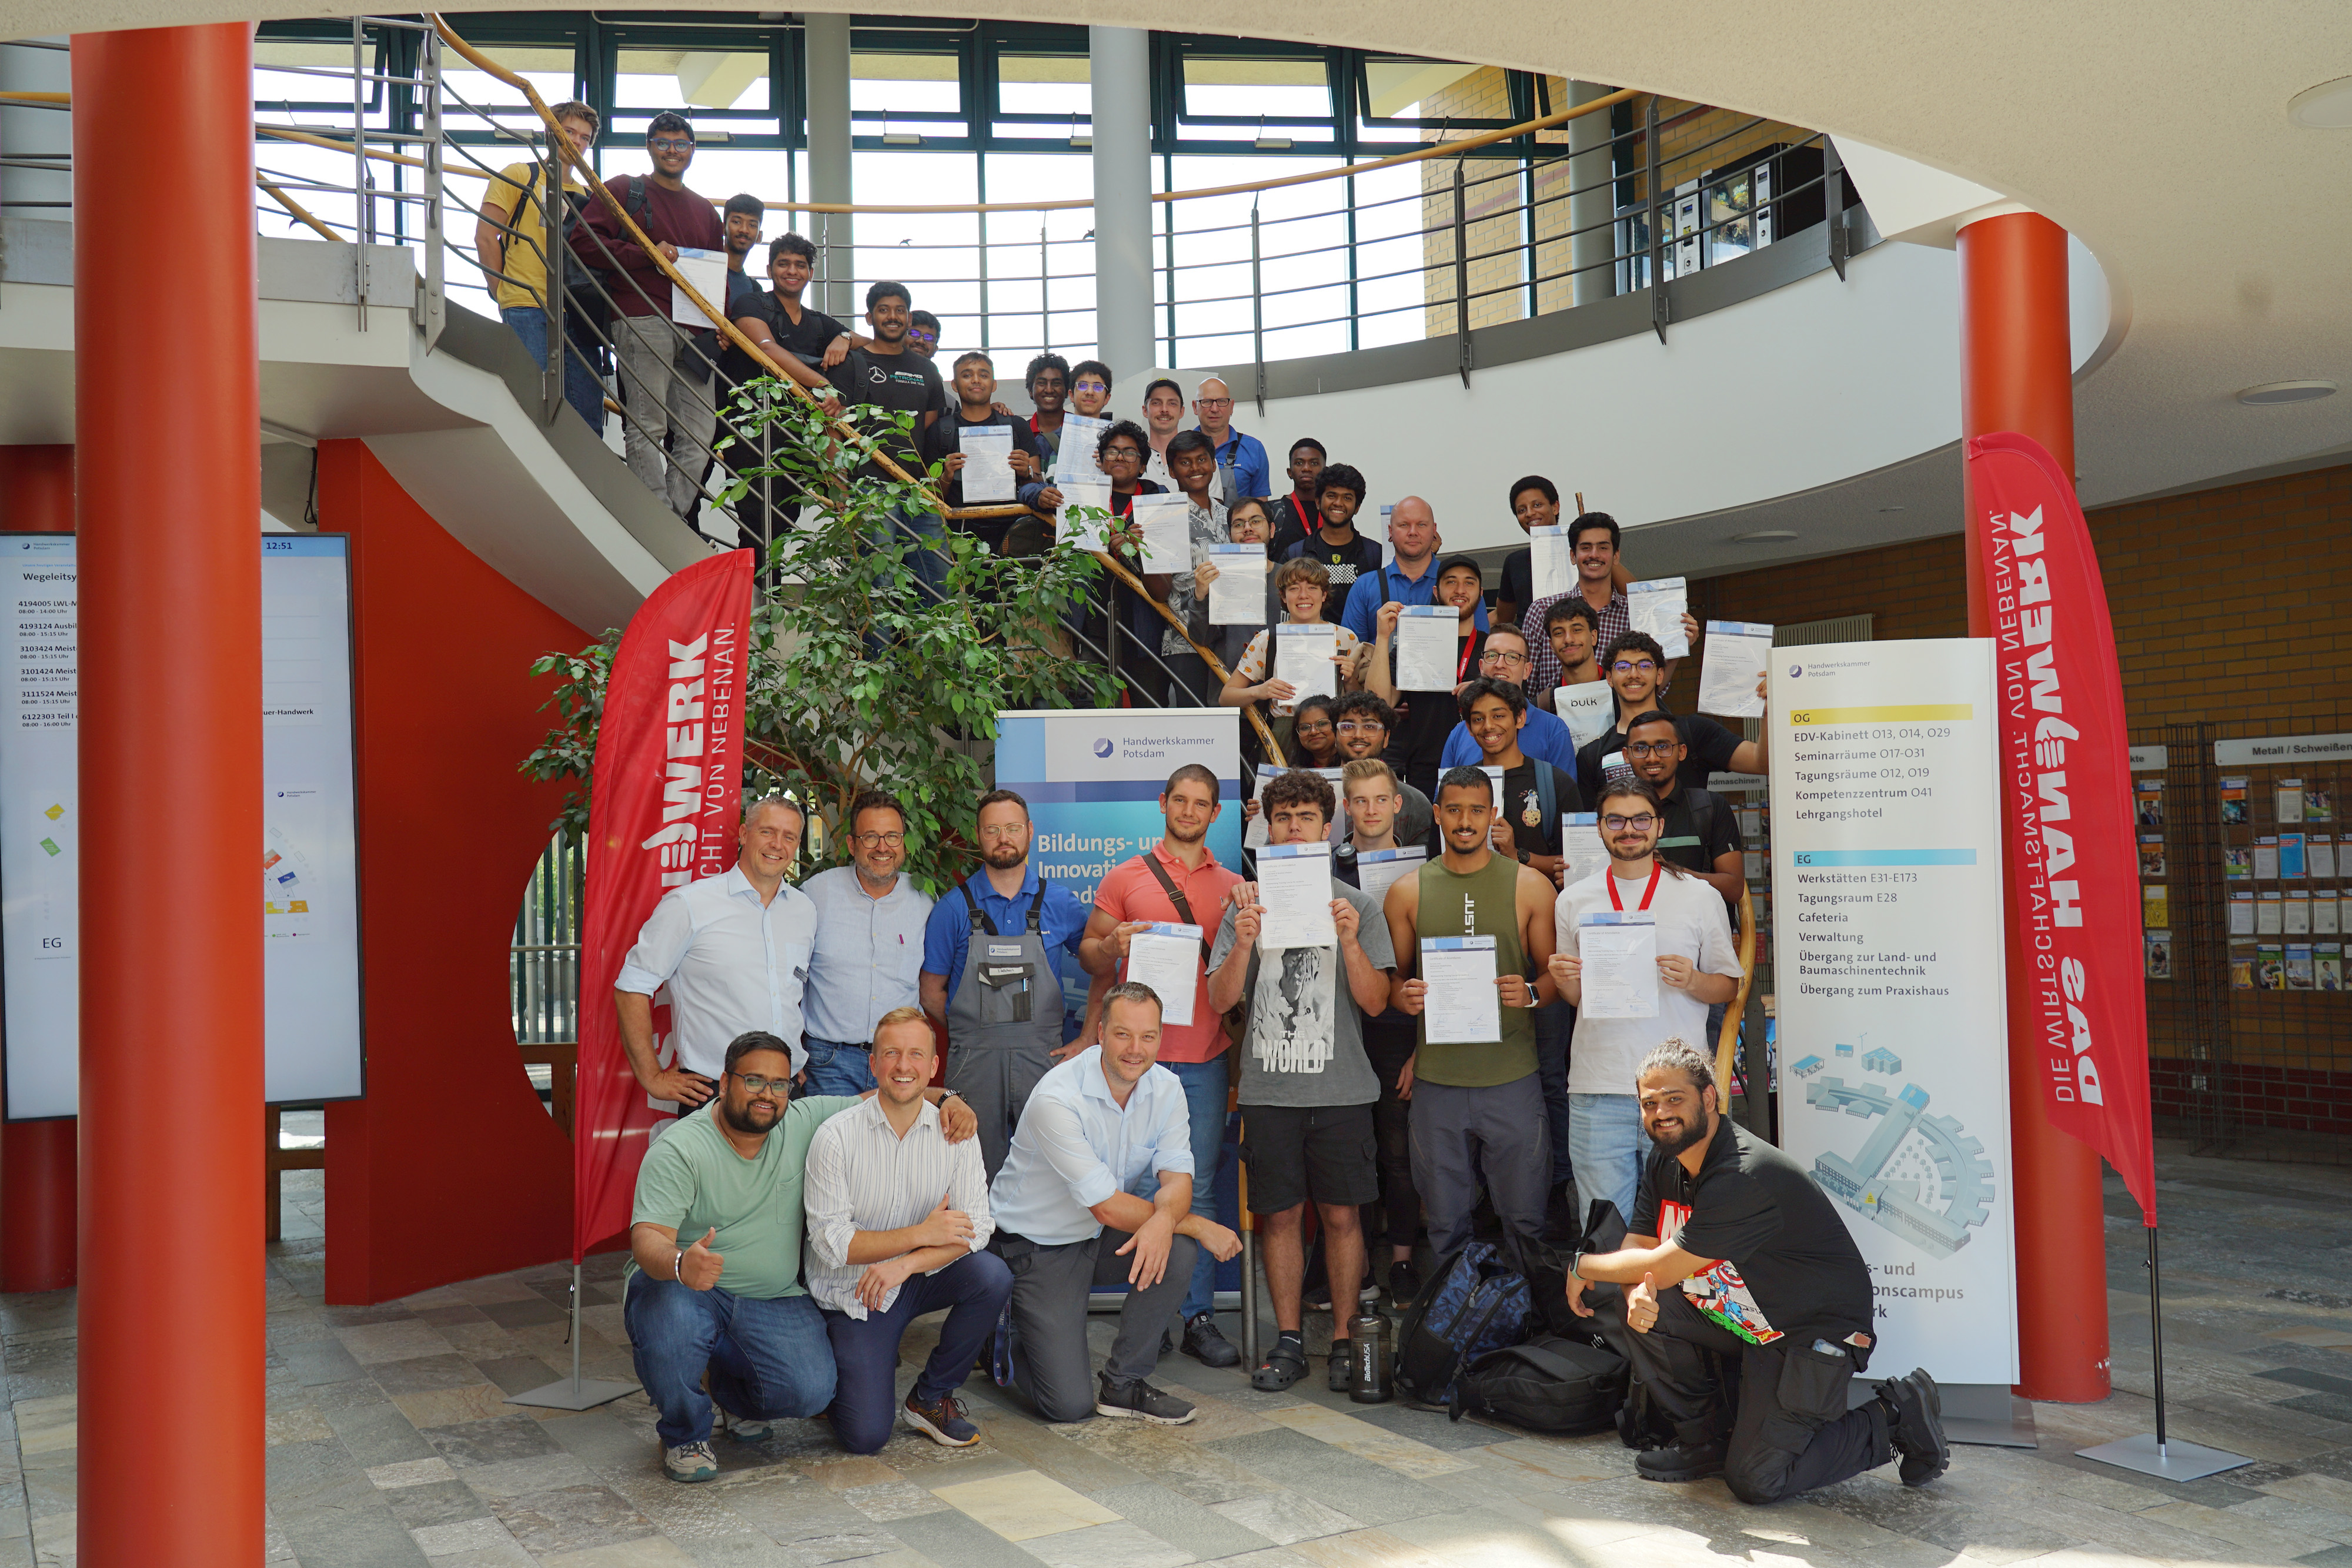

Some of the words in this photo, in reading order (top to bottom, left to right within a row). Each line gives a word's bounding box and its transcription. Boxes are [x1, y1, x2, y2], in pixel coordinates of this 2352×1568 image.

[890, 375, 924, 383] PETRONAS
[23, 573, 77, 583] Wegeleitsy
[1808, 661, 1871, 670] Handwerkskammer
[711, 622, 736, 753] NEBENAN.
[1571, 697, 1598, 707] bulk
[1793, 713, 1810, 723] OG
[1122, 736, 1215, 746] Handwerkskammer
[1794, 730, 1869, 743] EDV-Kabinett
[1122, 748, 1165, 758] Potsdam
[1795, 749, 1877, 763] Seminarräume
[2252, 746, 2284, 756] Metall
[2286, 746, 2290, 754] /
[2293, 743, 2352, 754] Schweißen
[2130, 754, 2145, 763] kte
[1708, 777, 1760, 785] ndmaschinen
[1795, 768, 1877, 783] Tagungsräume
[703, 762, 725, 817] VON
[1795, 788, 1908, 802] Kompetenzzentrum
[1796, 807, 1883, 822] Lehrgangshotel
[1038, 833, 1133, 857] Bildungs-
[1797, 855, 1811, 864] EG
[1798, 872, 1867, 884] Werkstätten
[1870, 872, 1918, 883] E31-E173
[1798, 893, 1873, 905] Tagungsraum
[1877, 892, 1897, 903] E28
[1464, 892, 1475, 936] JUST
[1798, 912, 1849, 923] Cafeteria
[43, 938, 62, 948] EG
[1799, 932, 1864, 945] Verwaltung
[1799, 950, 1853, 965] Übergang
[1857, 954, 1875, 962] zur
[1878, 952, 1910, 962] Land-
[1914, 951, 1937, 962] und
[1799, 965, 1926, 976] Baumaschinentechnik
[1800, 983, 1854, 998] Übergang
[1857, 987, 1882, 996] zum
[1886, 985, 1949, 997] Praxishaus
[1279, 1030, 1305, 1039] THE
[1262, 1038, 1325, 1074] WORLD
[1884, 1262, 1915, 1276] und
[1872, 1286, 1964, 1303] onscampus
[1363, 1343, 1371, 1382] BioTechUSA
